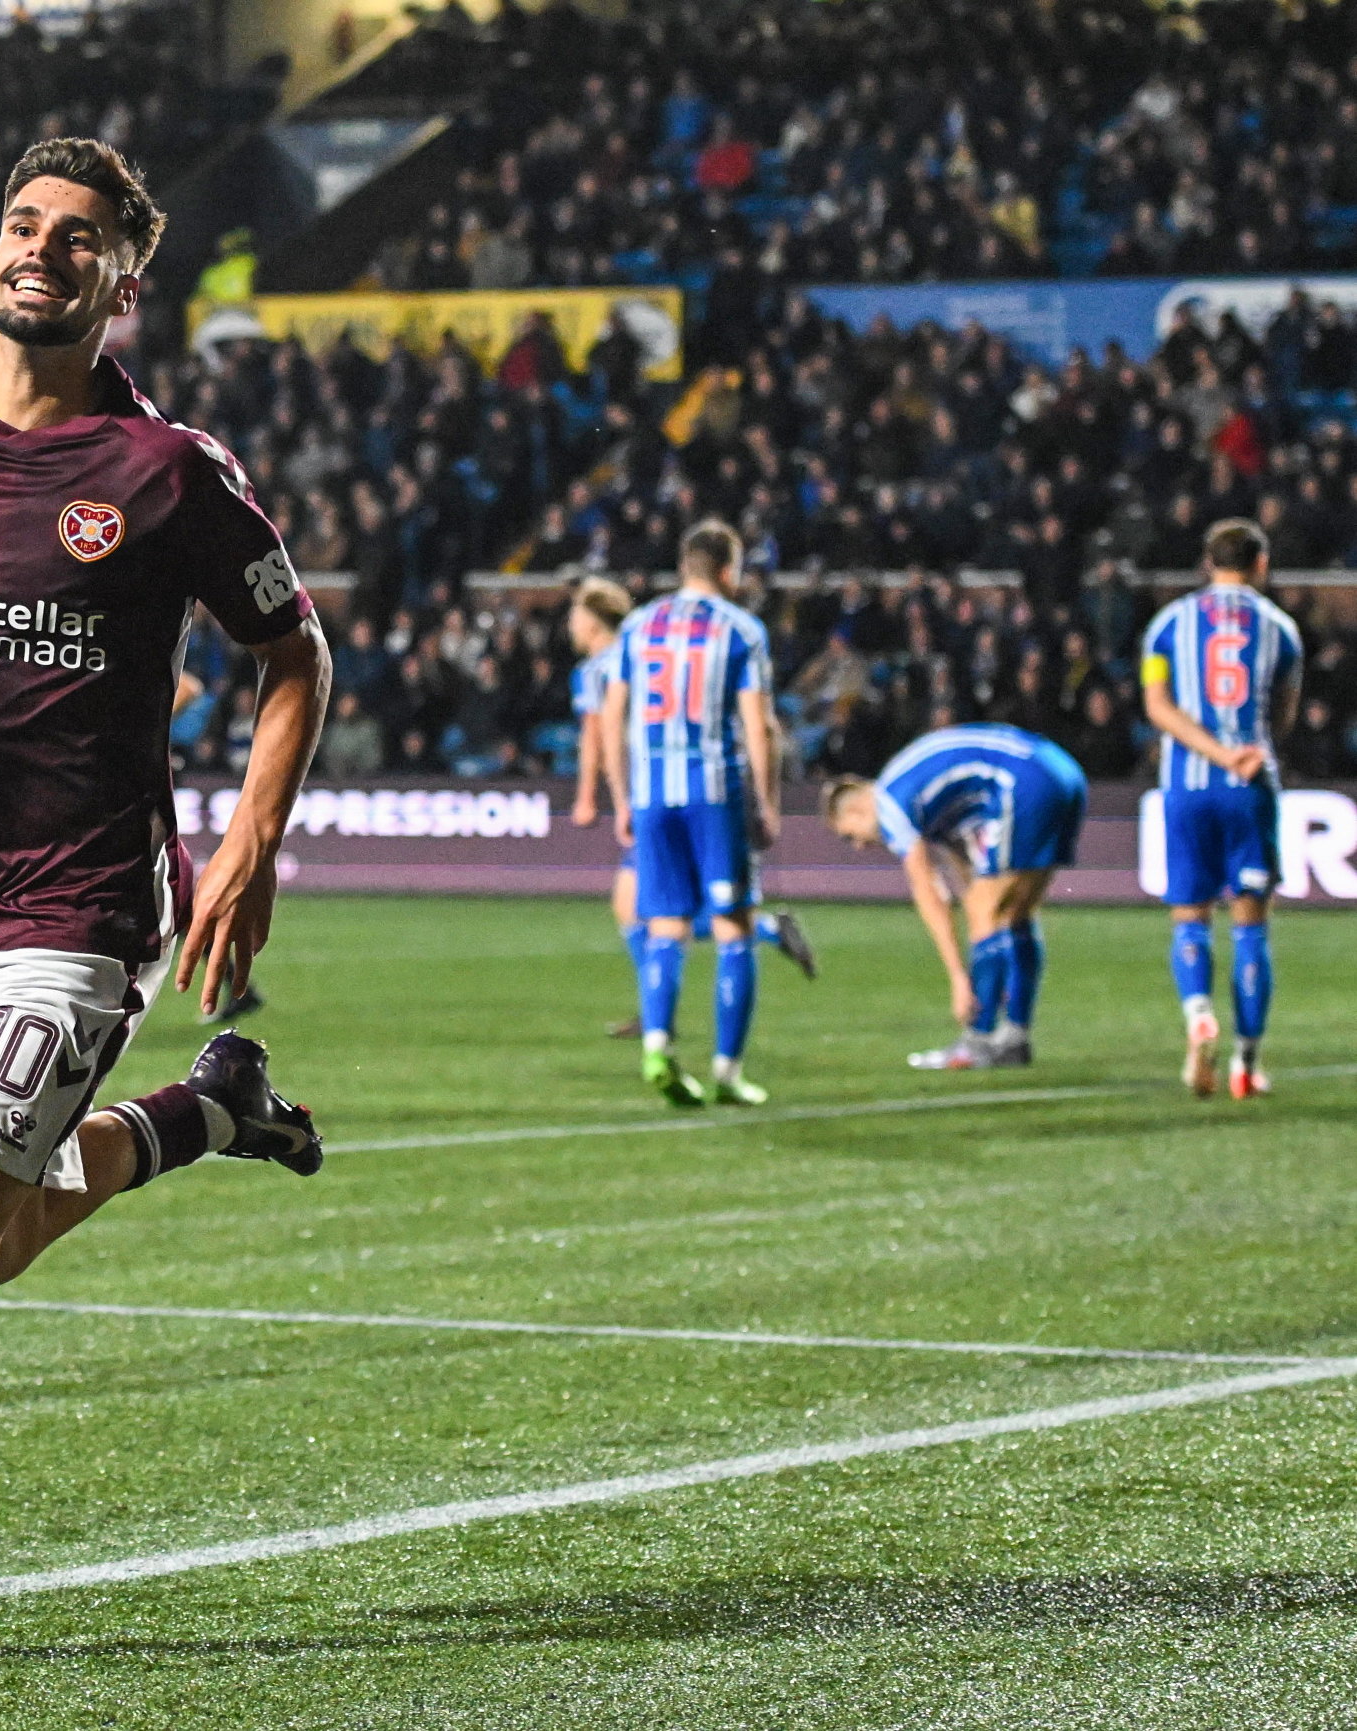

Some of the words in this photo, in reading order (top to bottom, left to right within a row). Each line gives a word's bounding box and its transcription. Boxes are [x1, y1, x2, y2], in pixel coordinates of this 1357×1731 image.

[80, 542, 97, 550] 1874
[641, 645, 706, 723] 31
[1204, 632, 1250, 708] 6
[208, 788, 550, 838] SPPRESSION
